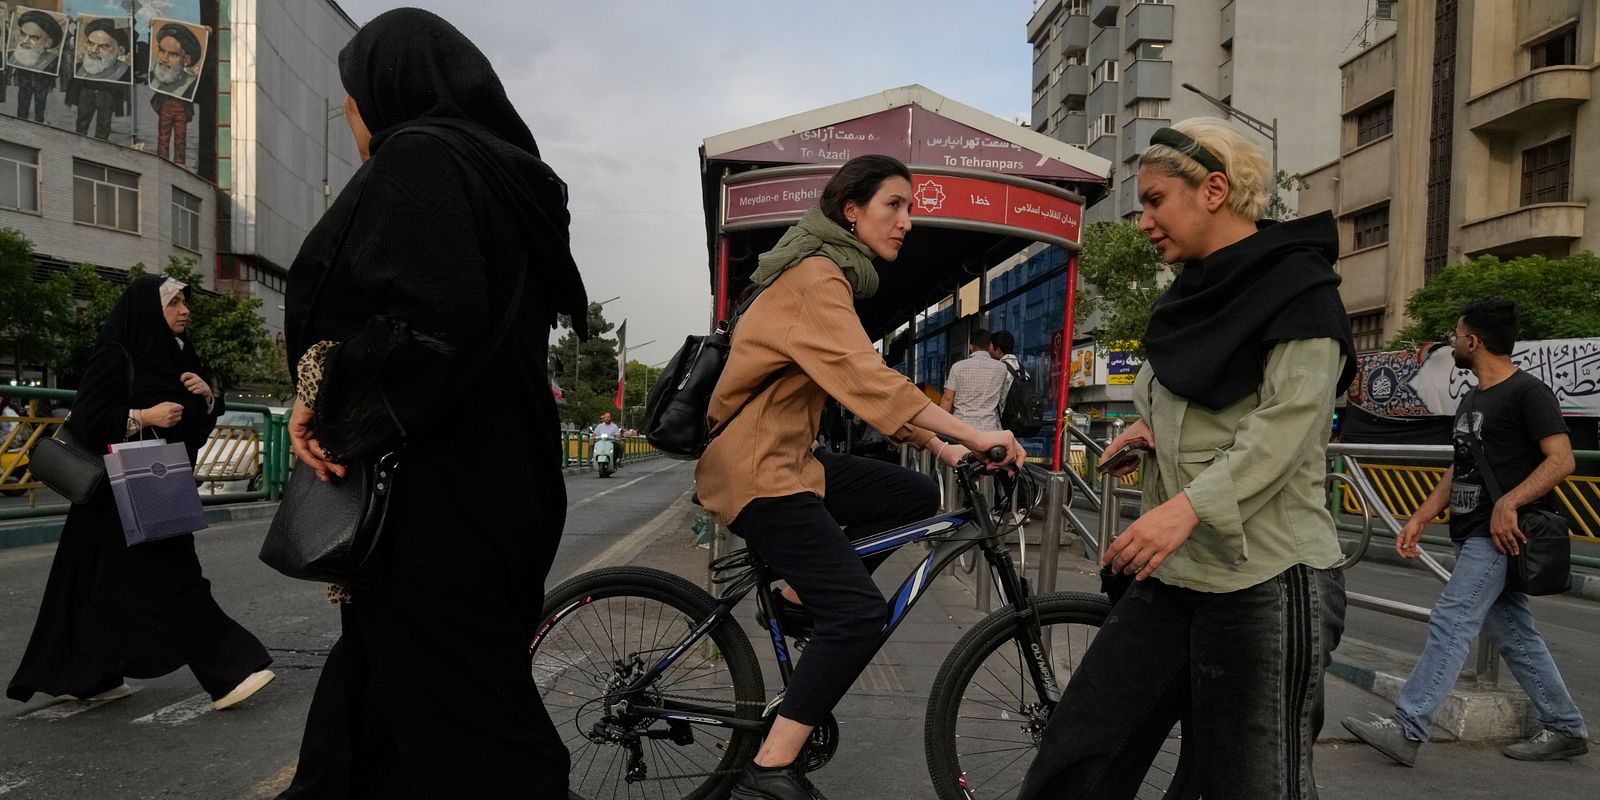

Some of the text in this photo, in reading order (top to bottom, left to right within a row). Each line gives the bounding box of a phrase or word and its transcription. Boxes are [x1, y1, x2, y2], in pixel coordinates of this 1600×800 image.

[800, 126, 835, 142] آزادی
[835, 131, 866, 141] سمت
[981, 138, 1009, 148] سمت
[818, 148, 850, 160] Azadi
[943, 155, 1024, 170] To Tehranpars
[739, 188, 823, 207] Meydan-e Enghela
[1014, 203, 1077, 226] میدان انقلاب اسلامی
